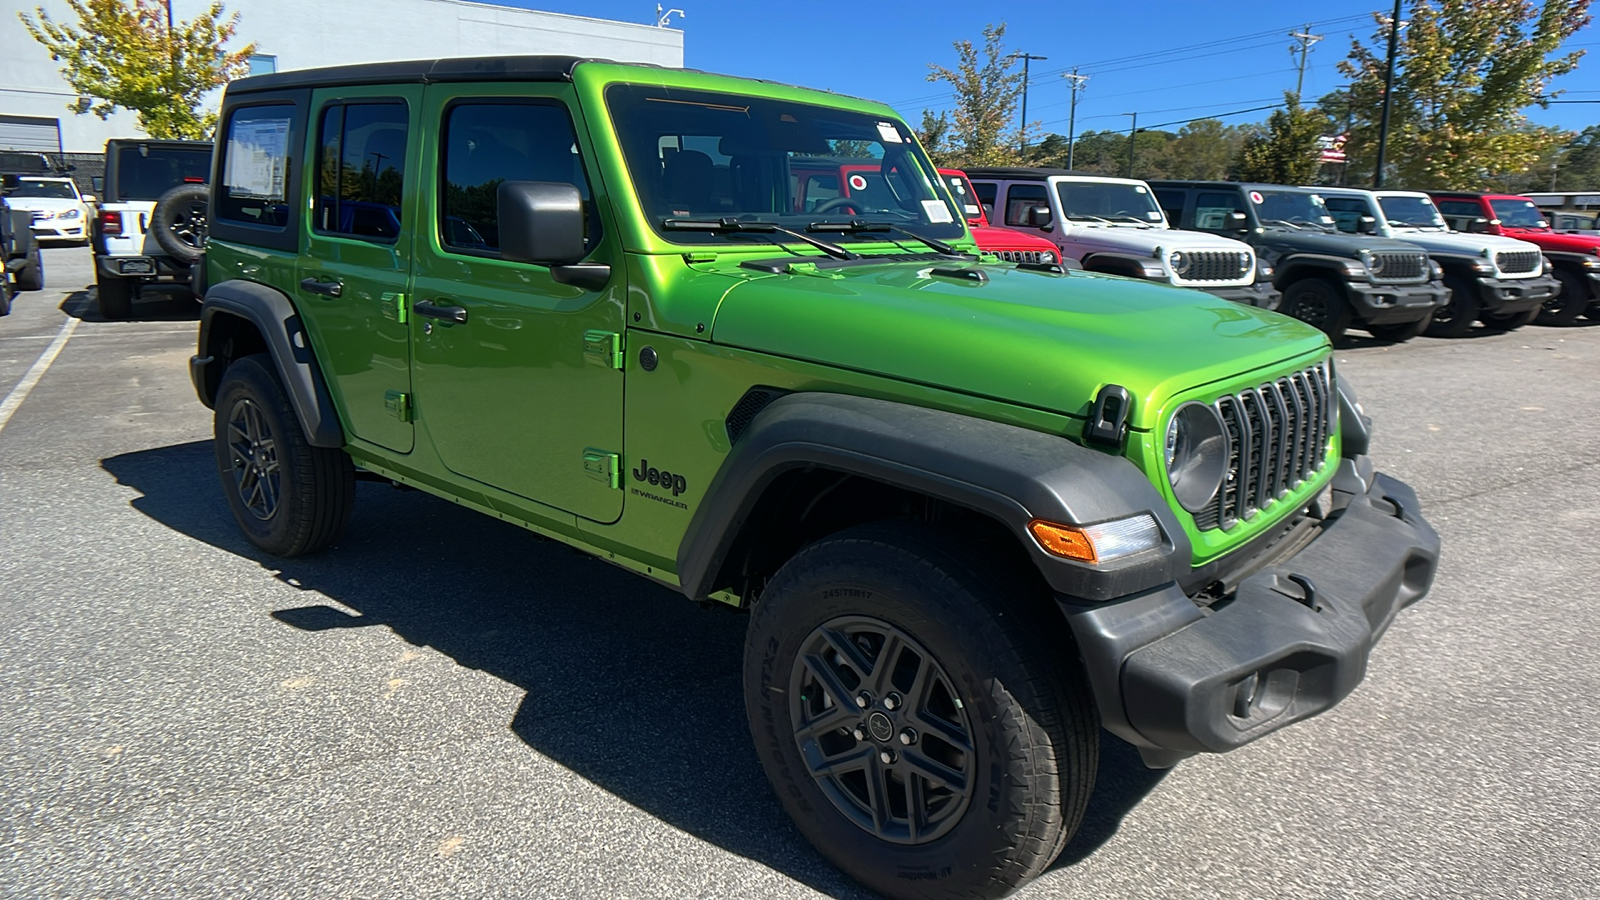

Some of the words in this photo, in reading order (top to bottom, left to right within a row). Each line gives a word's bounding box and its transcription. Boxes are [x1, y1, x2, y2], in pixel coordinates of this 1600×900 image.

[633, 459, 687, 497] Jeep
[638, 490, 688, 511] WRANGLER
[822, 588, 873, 600] 245/75R17
